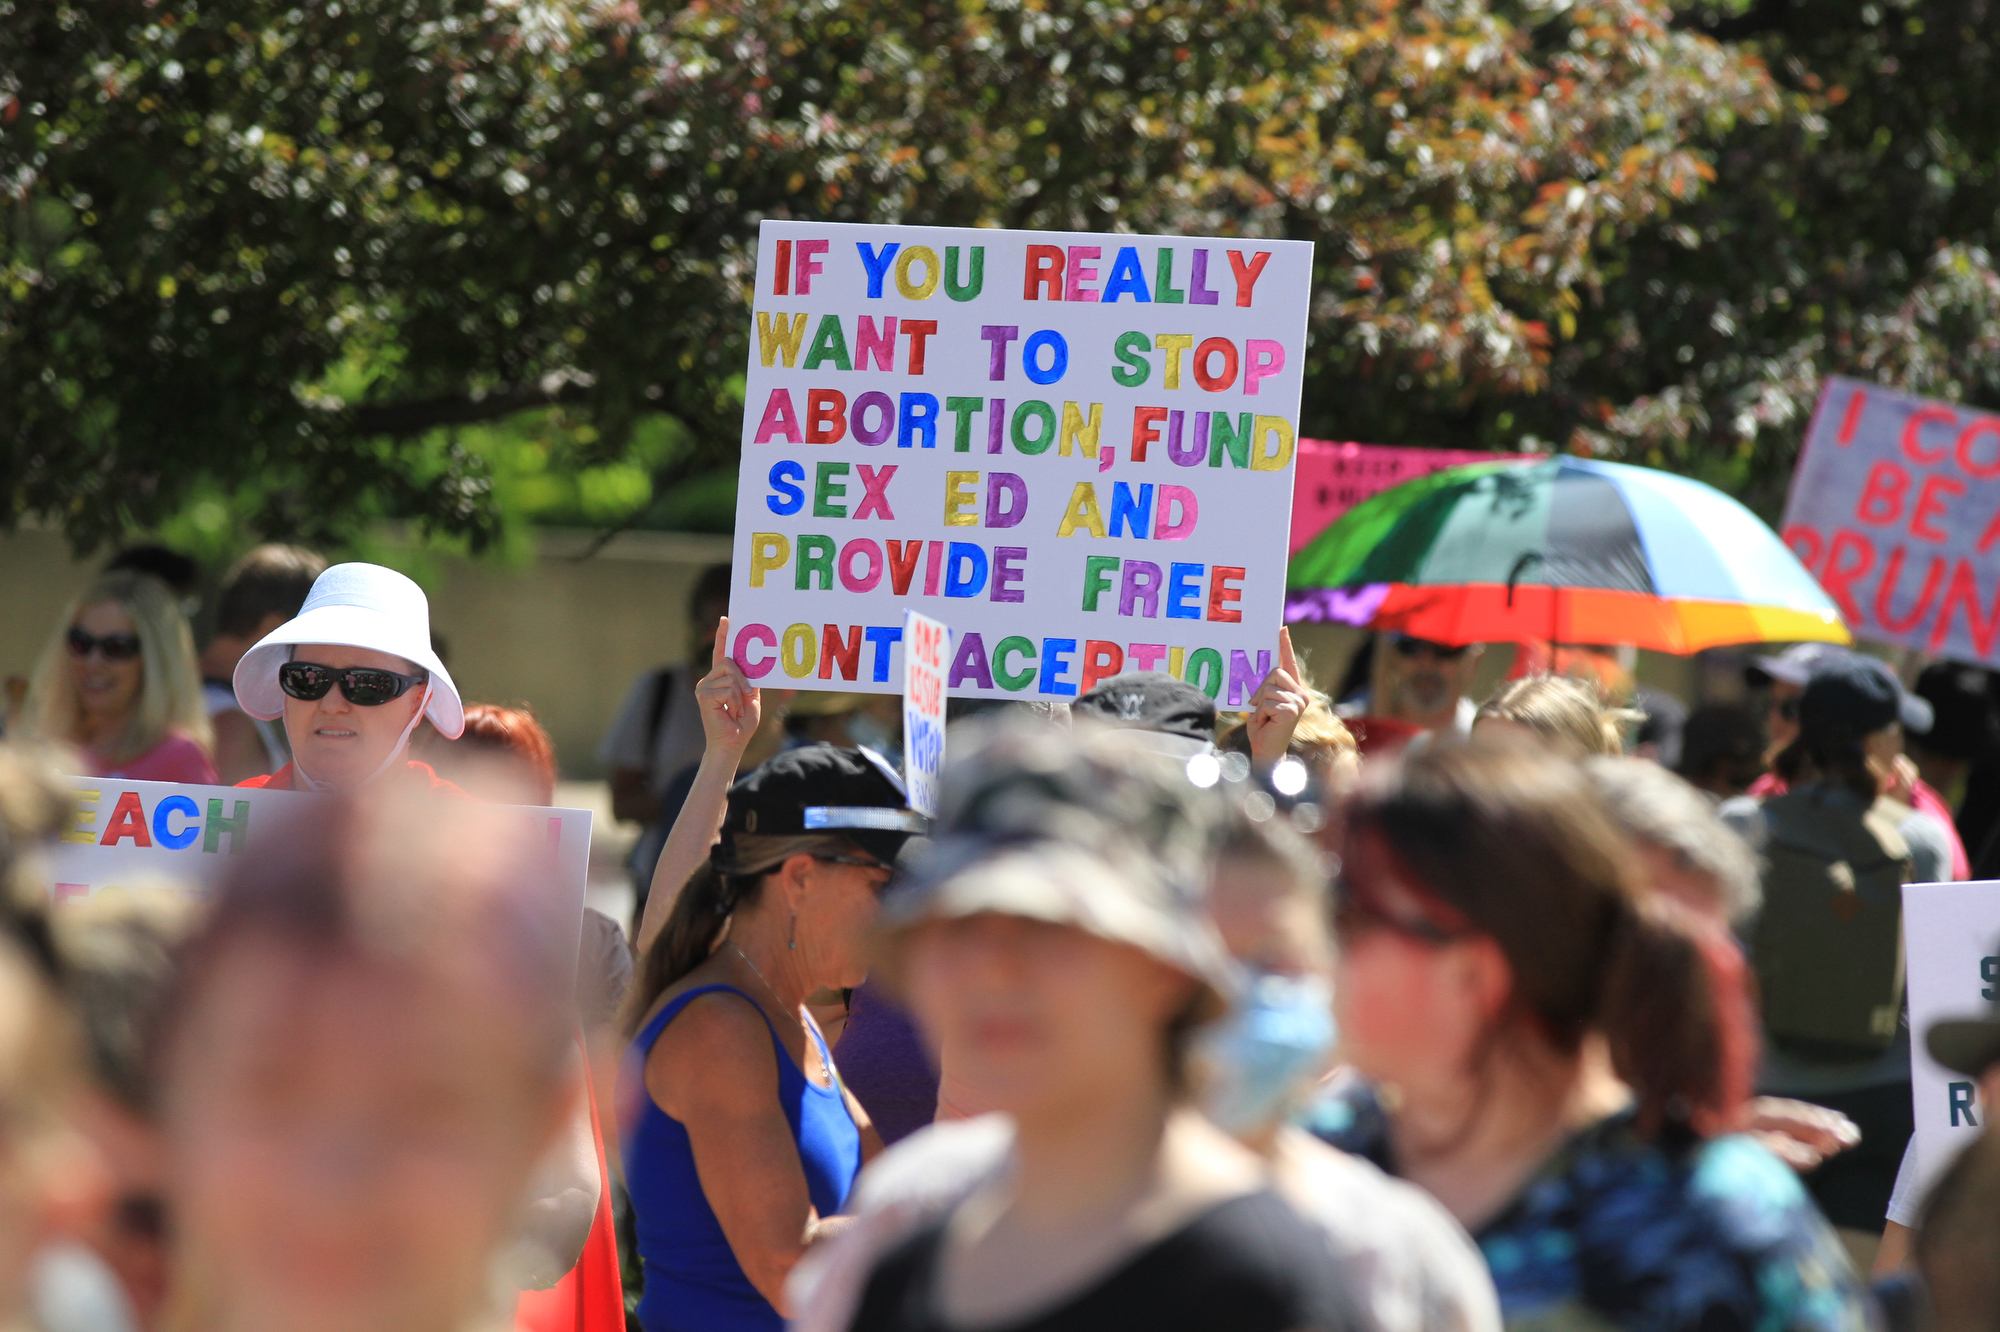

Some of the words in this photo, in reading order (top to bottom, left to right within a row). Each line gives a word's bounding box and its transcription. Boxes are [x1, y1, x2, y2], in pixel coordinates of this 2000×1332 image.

[774, 240, 829, 295] IF
[856, 242, 984, 301] YOU
[1024, 245, 1271, 307] REALLY
[757, 312, 937, 375] WANT
[982, 325, 1069, 385] TO
[1113, 332, 1285, 395] STOP
[754, 389, 1115, 474] ABORTION,
[1131, 407, 1294, 471] FUND
[1837, 388, 1867, 446] I
[766, 460, 898, 520] SEX
[945, 471, 1028, 528] ED
[1057, 481, 1198, 541] AND
[1854, 458, 1967, 545] BE
[750, 533, 1027, 602] PROVIDE
[1083, 556, 1246, 623] FREE
[733, 623, 1271, 706] CONTACEPTION
